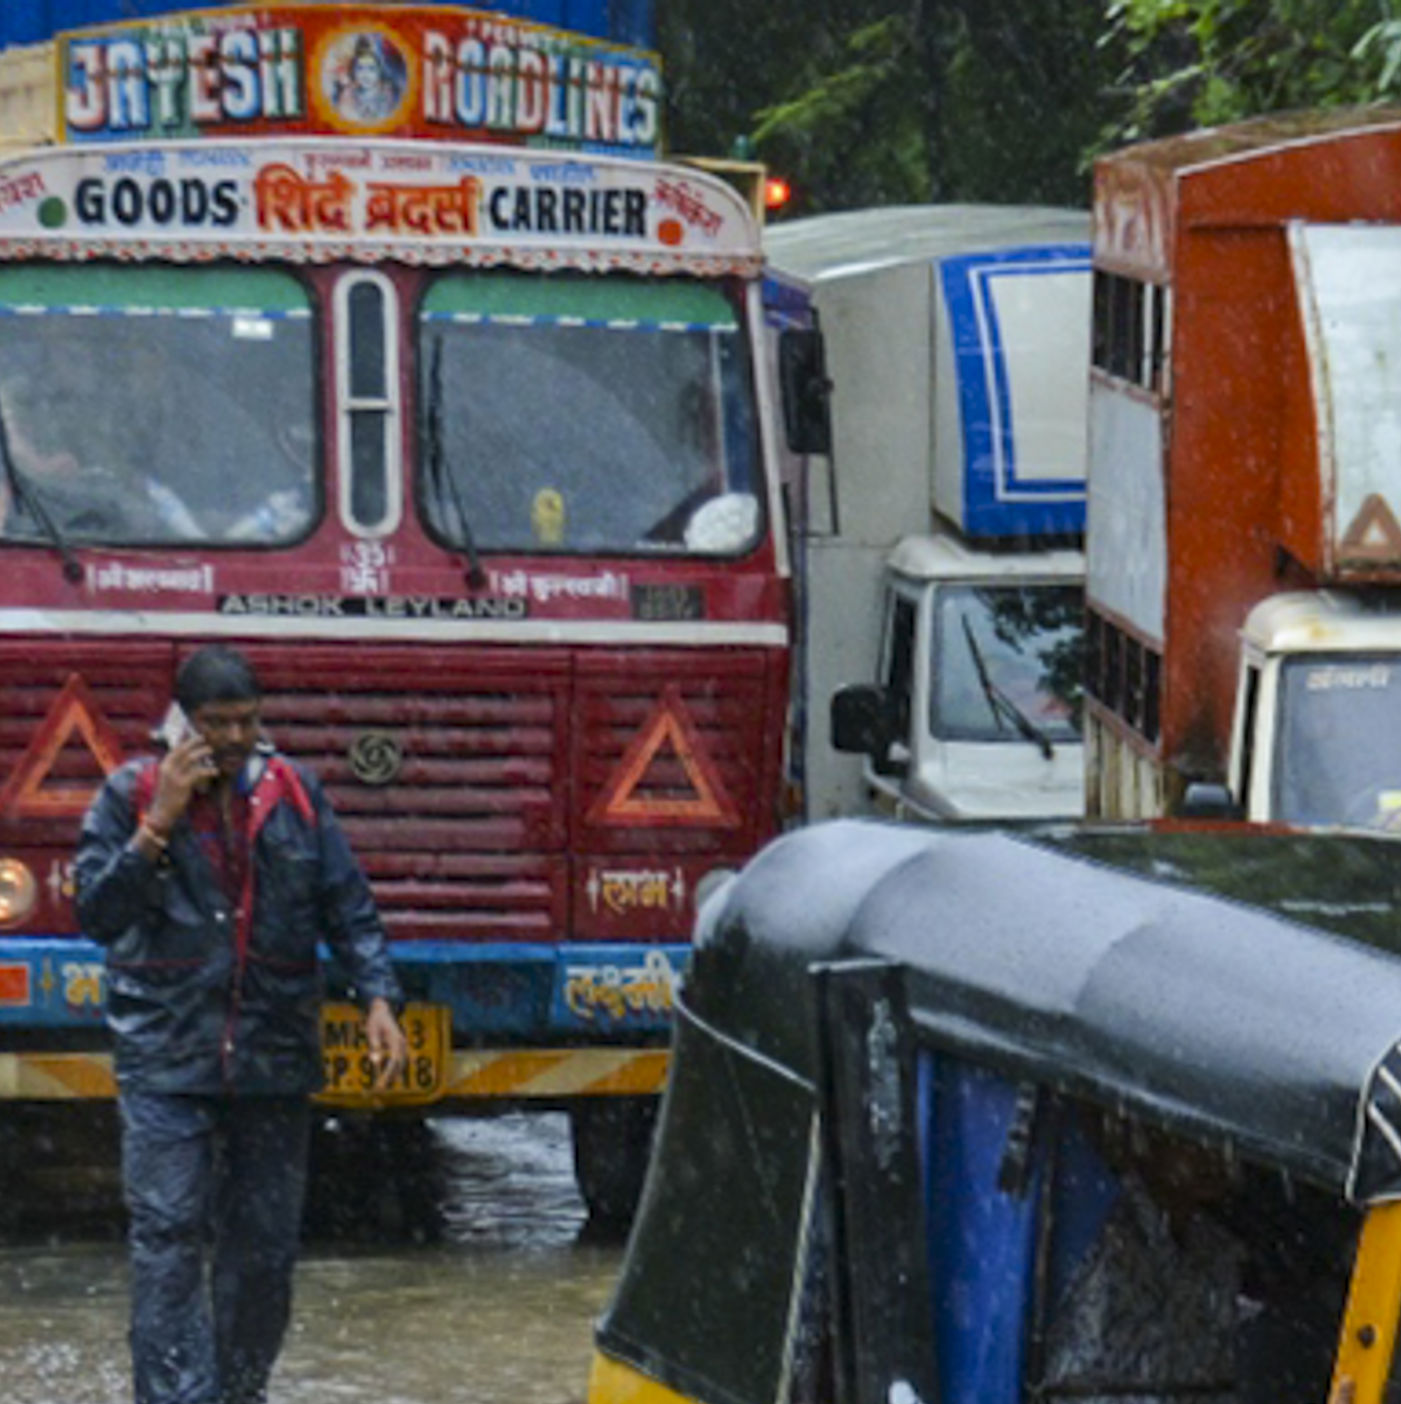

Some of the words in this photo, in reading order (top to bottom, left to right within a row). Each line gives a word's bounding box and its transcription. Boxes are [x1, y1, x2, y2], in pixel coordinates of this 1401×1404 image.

[65, 30, 303, 131] JAYESH
[423, 30, 658, 144] ROADLINES
[74, 177, 240, 227] GOODS
[489, 185, 647, 238] CARRIER
[220, 594, 344, 616] ASHOK
[365, 596, 527, 618] LEYLAND
